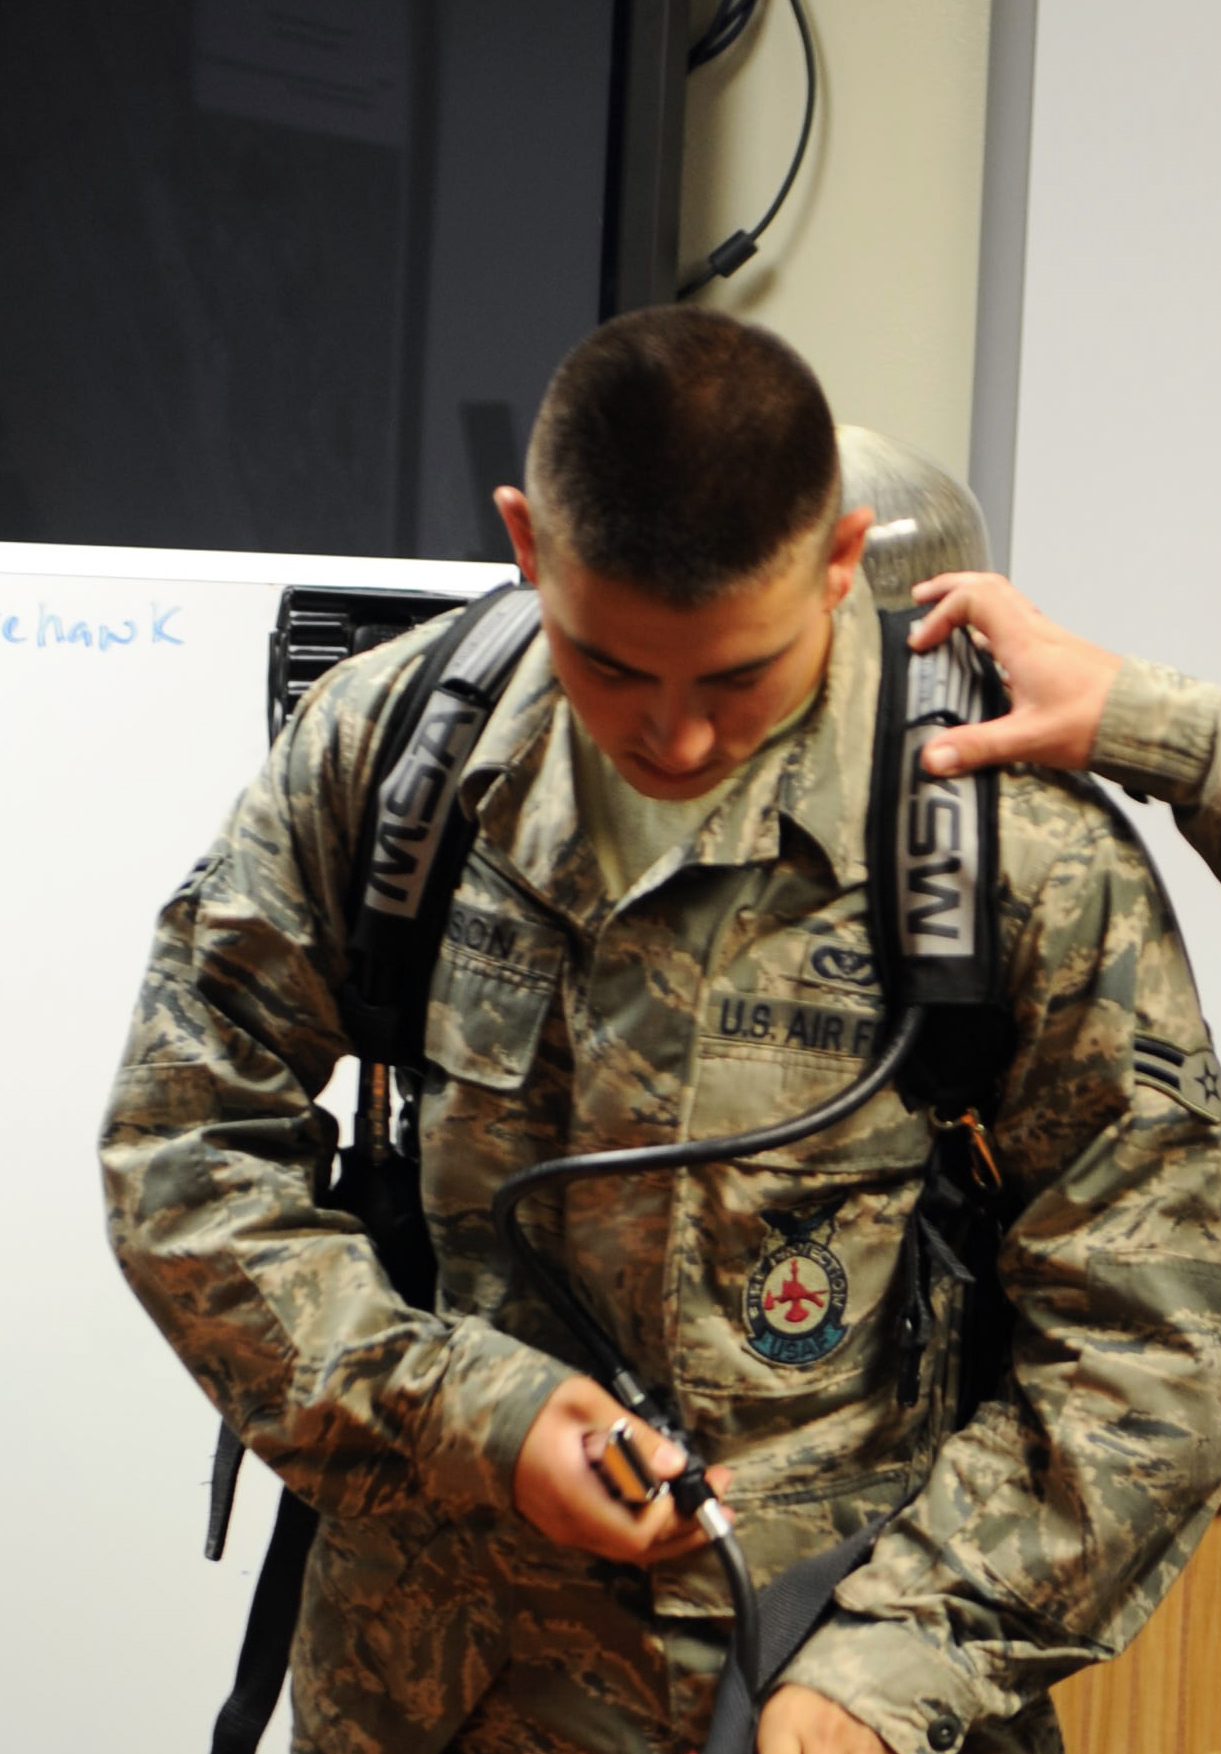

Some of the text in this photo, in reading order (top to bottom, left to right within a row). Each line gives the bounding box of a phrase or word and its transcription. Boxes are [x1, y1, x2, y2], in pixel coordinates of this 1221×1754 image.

[370, 710, 478, 902] MSA
[720, 998, 776, 1041] U.S.
[785, 1009, 844, 1051] AIR
